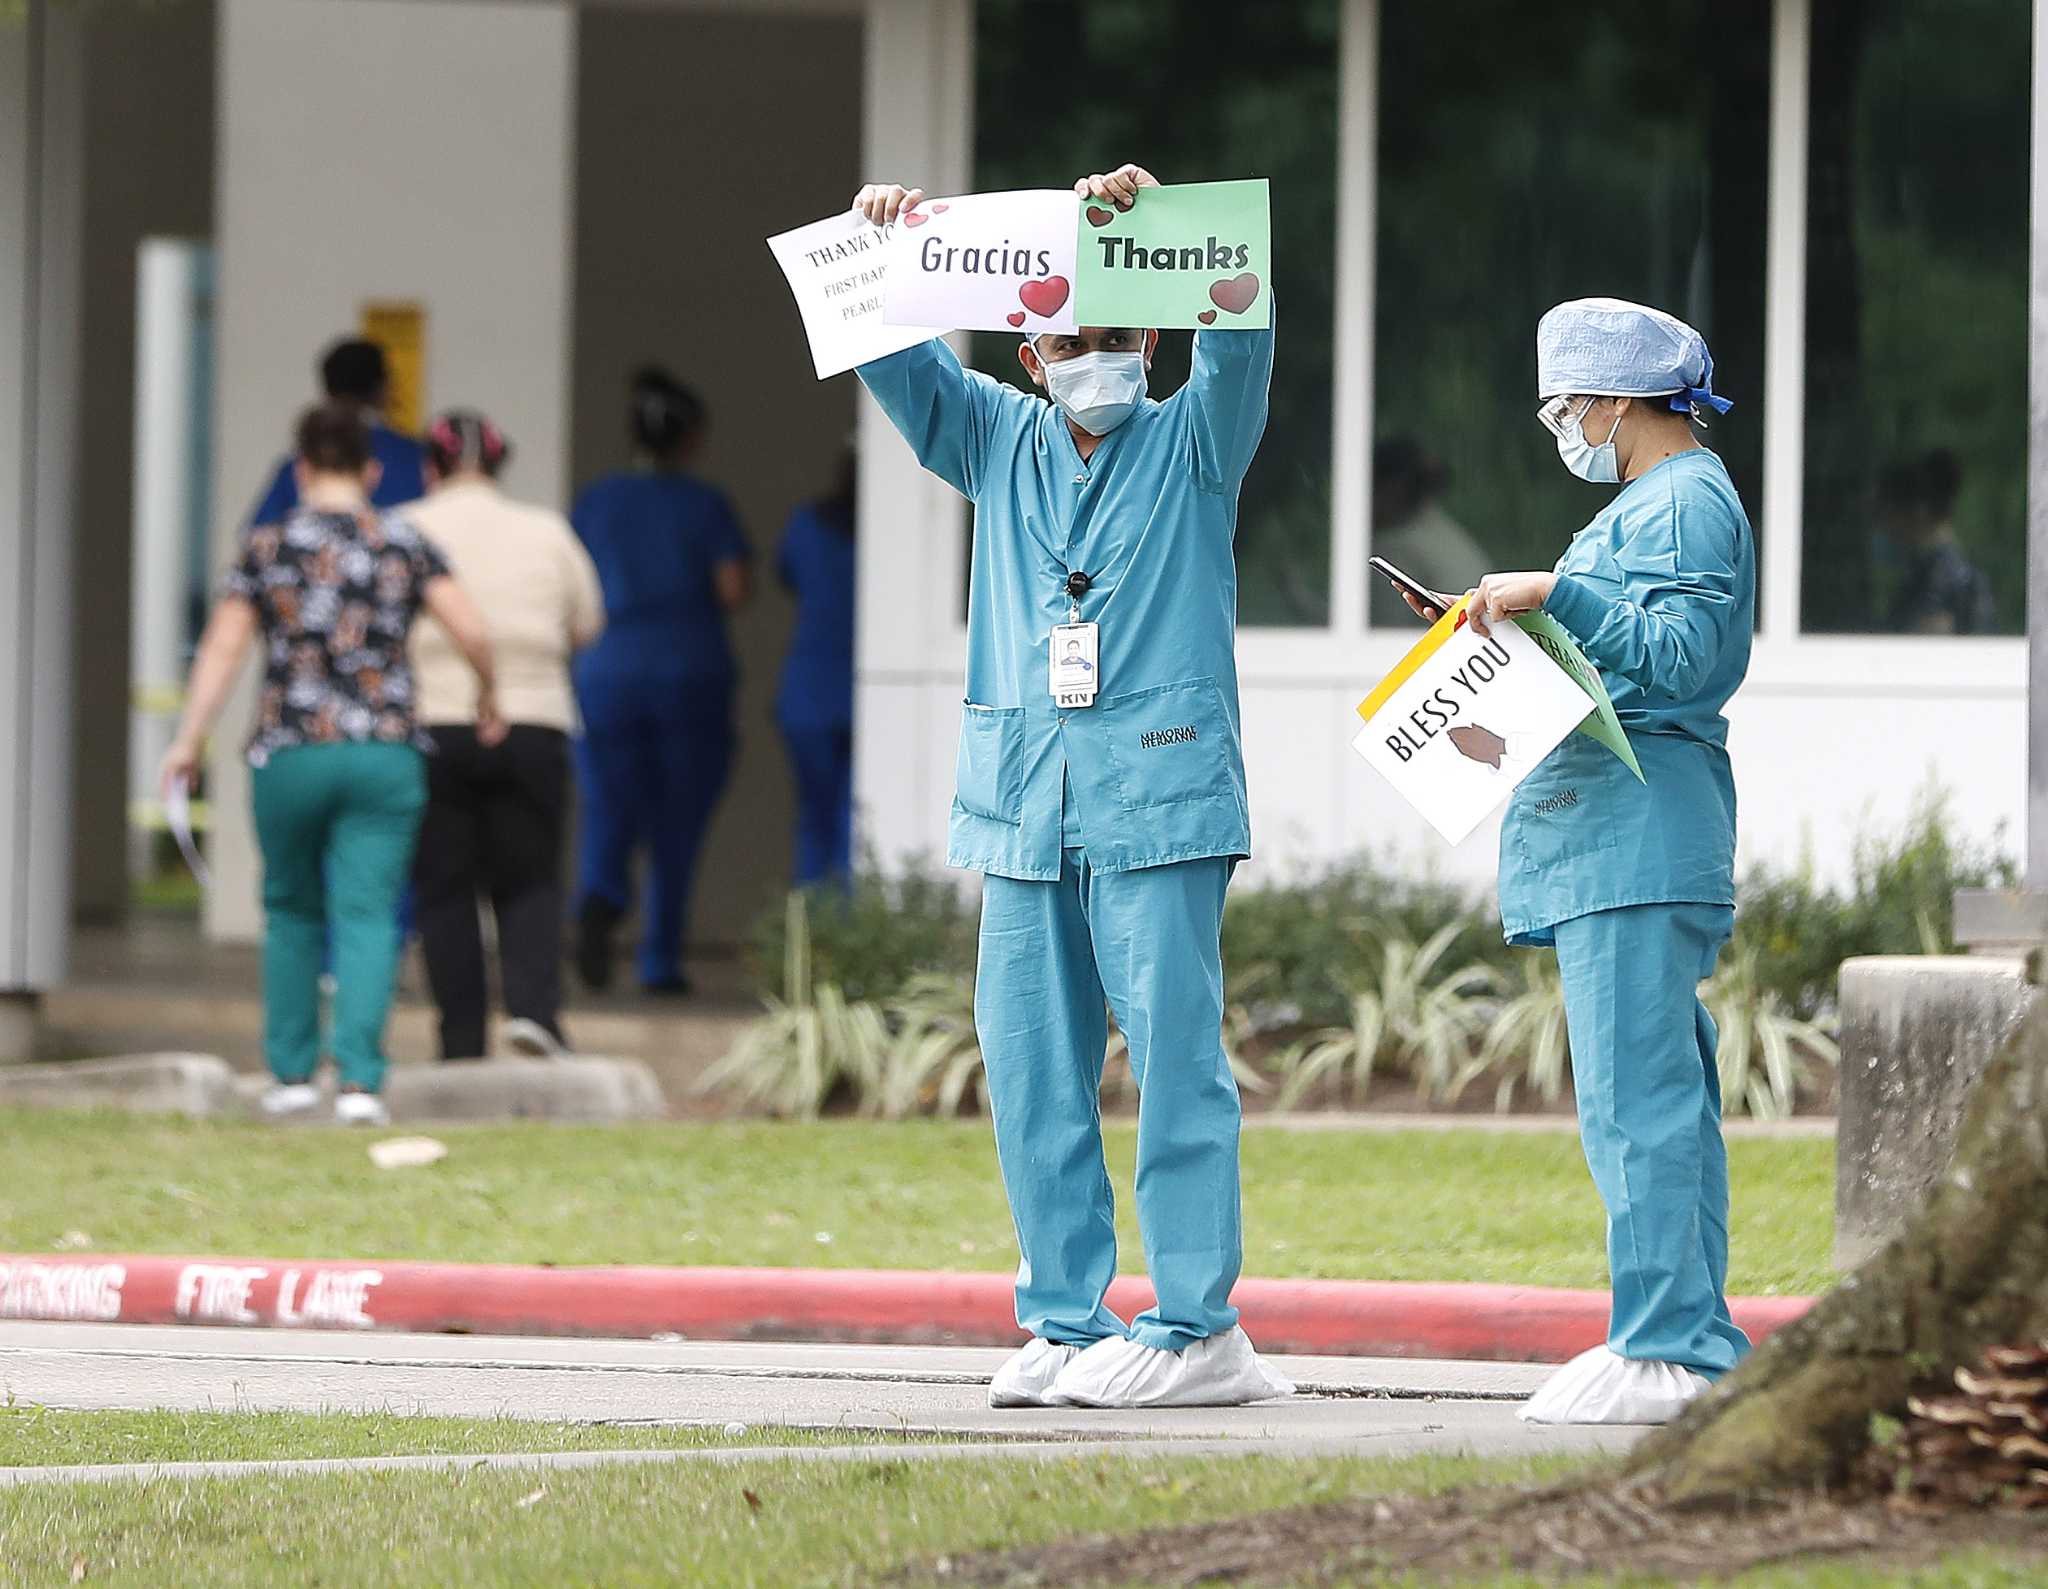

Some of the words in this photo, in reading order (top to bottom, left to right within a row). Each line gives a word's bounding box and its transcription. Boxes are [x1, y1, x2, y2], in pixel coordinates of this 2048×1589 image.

[805, 235, 870, 267] THANK
[920, 236, 1051, 276] Gracias
[1097, 236, 1250, 271] Thanks
[824, 275, 858, 298] FIRST
[859, 264, 888, 285] BAP
[1385, 688, 1460, 762] BLESS
[1450, 637, 1511, 695] YOU
[176, 1264, 269, 1323] FIRE
[275, 1268, 384, 1330] LANE
